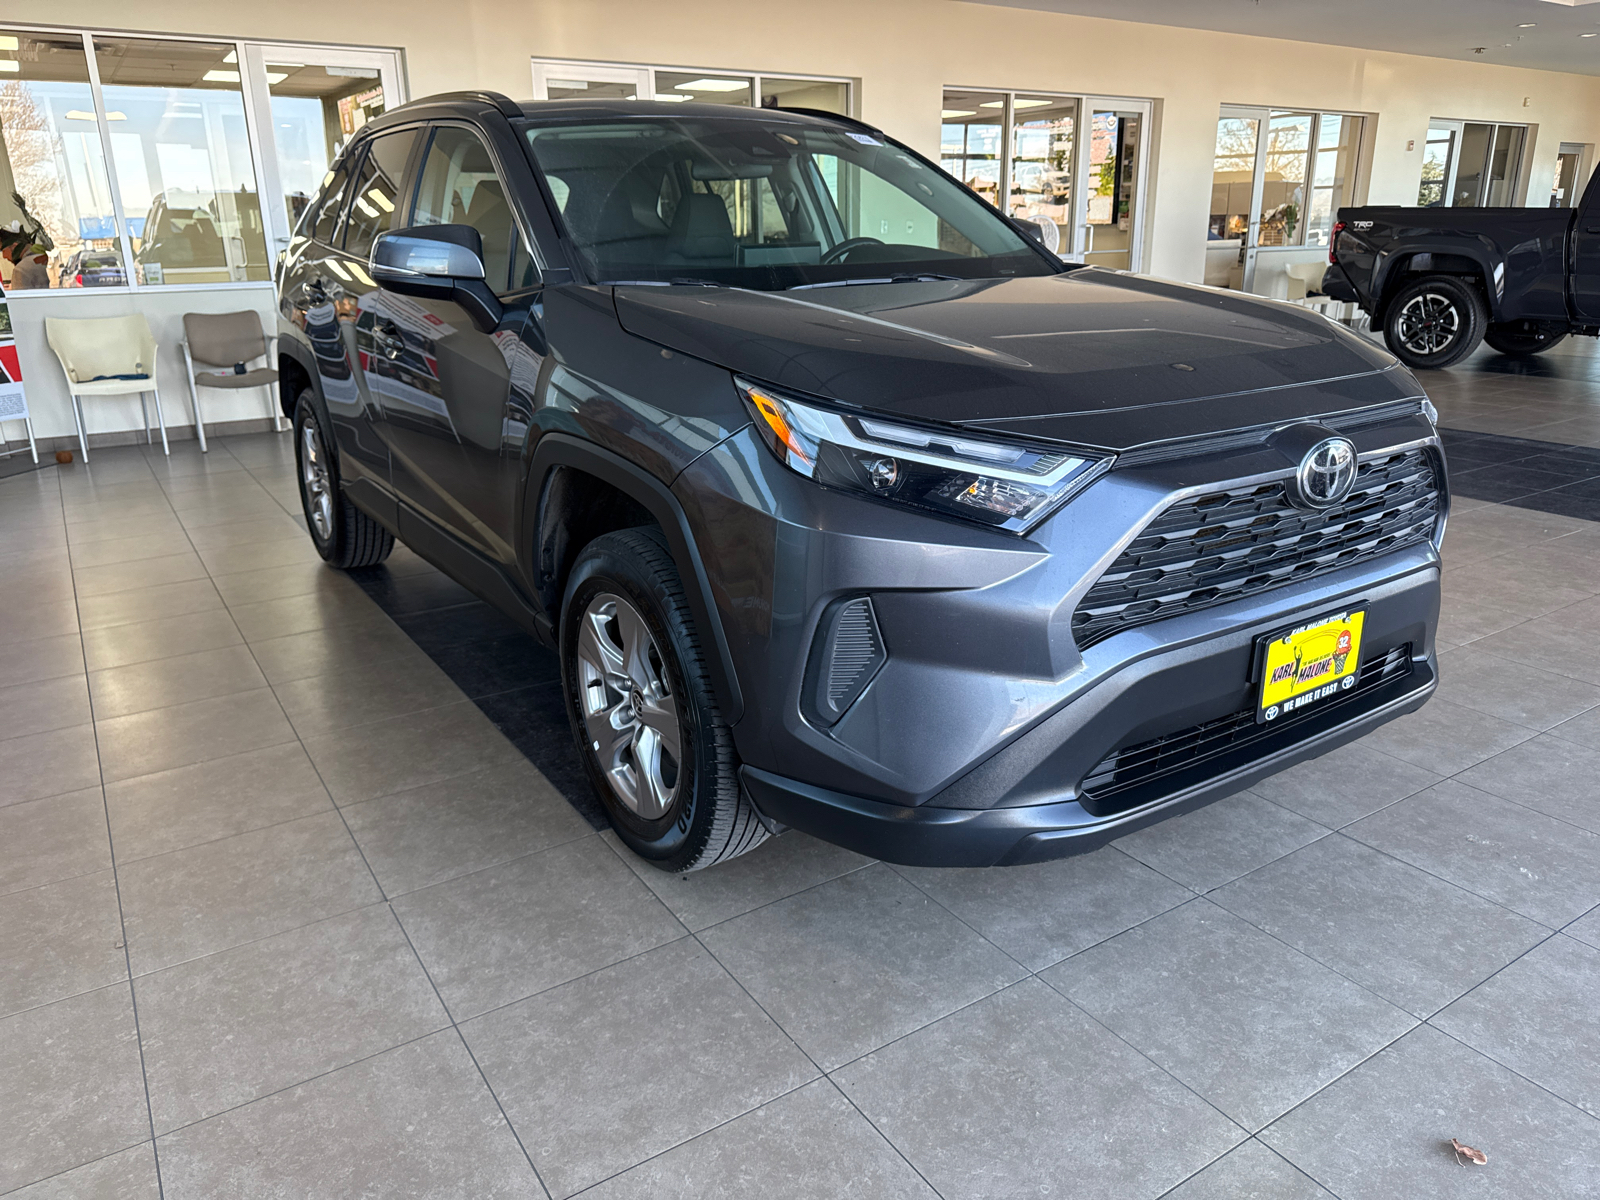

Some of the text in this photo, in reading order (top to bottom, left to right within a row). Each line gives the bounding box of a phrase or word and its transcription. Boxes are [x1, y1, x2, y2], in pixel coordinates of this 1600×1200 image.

[1338, 635, 1349, 649] 32
[1270, 662, 1295, 685] KARL
[1296, 658, 1332, 685] MALONE
[1283, 682, 1338, 712] WE MAKE IT EASY
